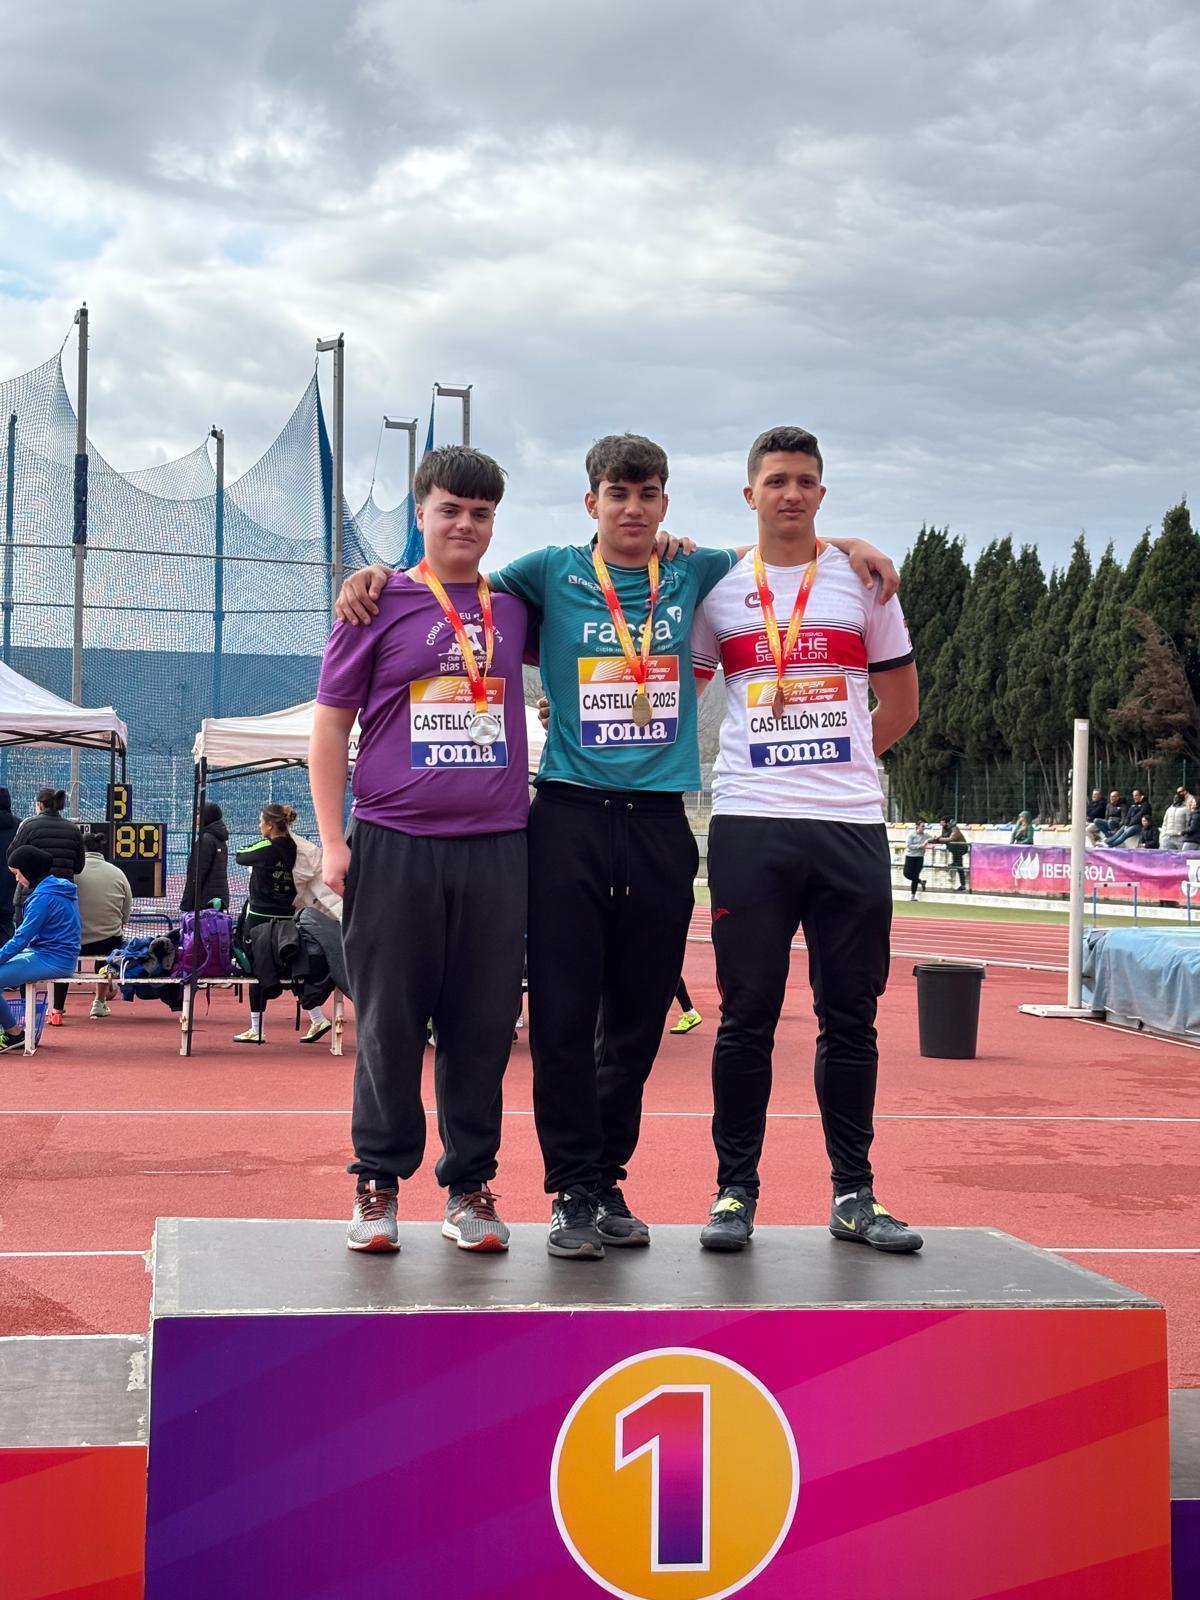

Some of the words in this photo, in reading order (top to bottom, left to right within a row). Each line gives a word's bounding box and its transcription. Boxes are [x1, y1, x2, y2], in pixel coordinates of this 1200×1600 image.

[426, 621, 445, 646] COIDA
[754, 637, 828, 654] EHE
[440, 661, 460, 672] Rías
[756, 651, 828, 663] DETLON
[652, 691, 677, 708] 2025
[414, 711, 475, 731] CASTELLÓ
[750, 710, 819, 733] CASTELLÓN
[821, 711, 848, 728] 2025
[764, 741, 840, 766] Joma
[116, 825, 159, 858] 80
[1042, 863, 1116, 882] IBERROLA
[615, 1384, 711, 1573] 1
